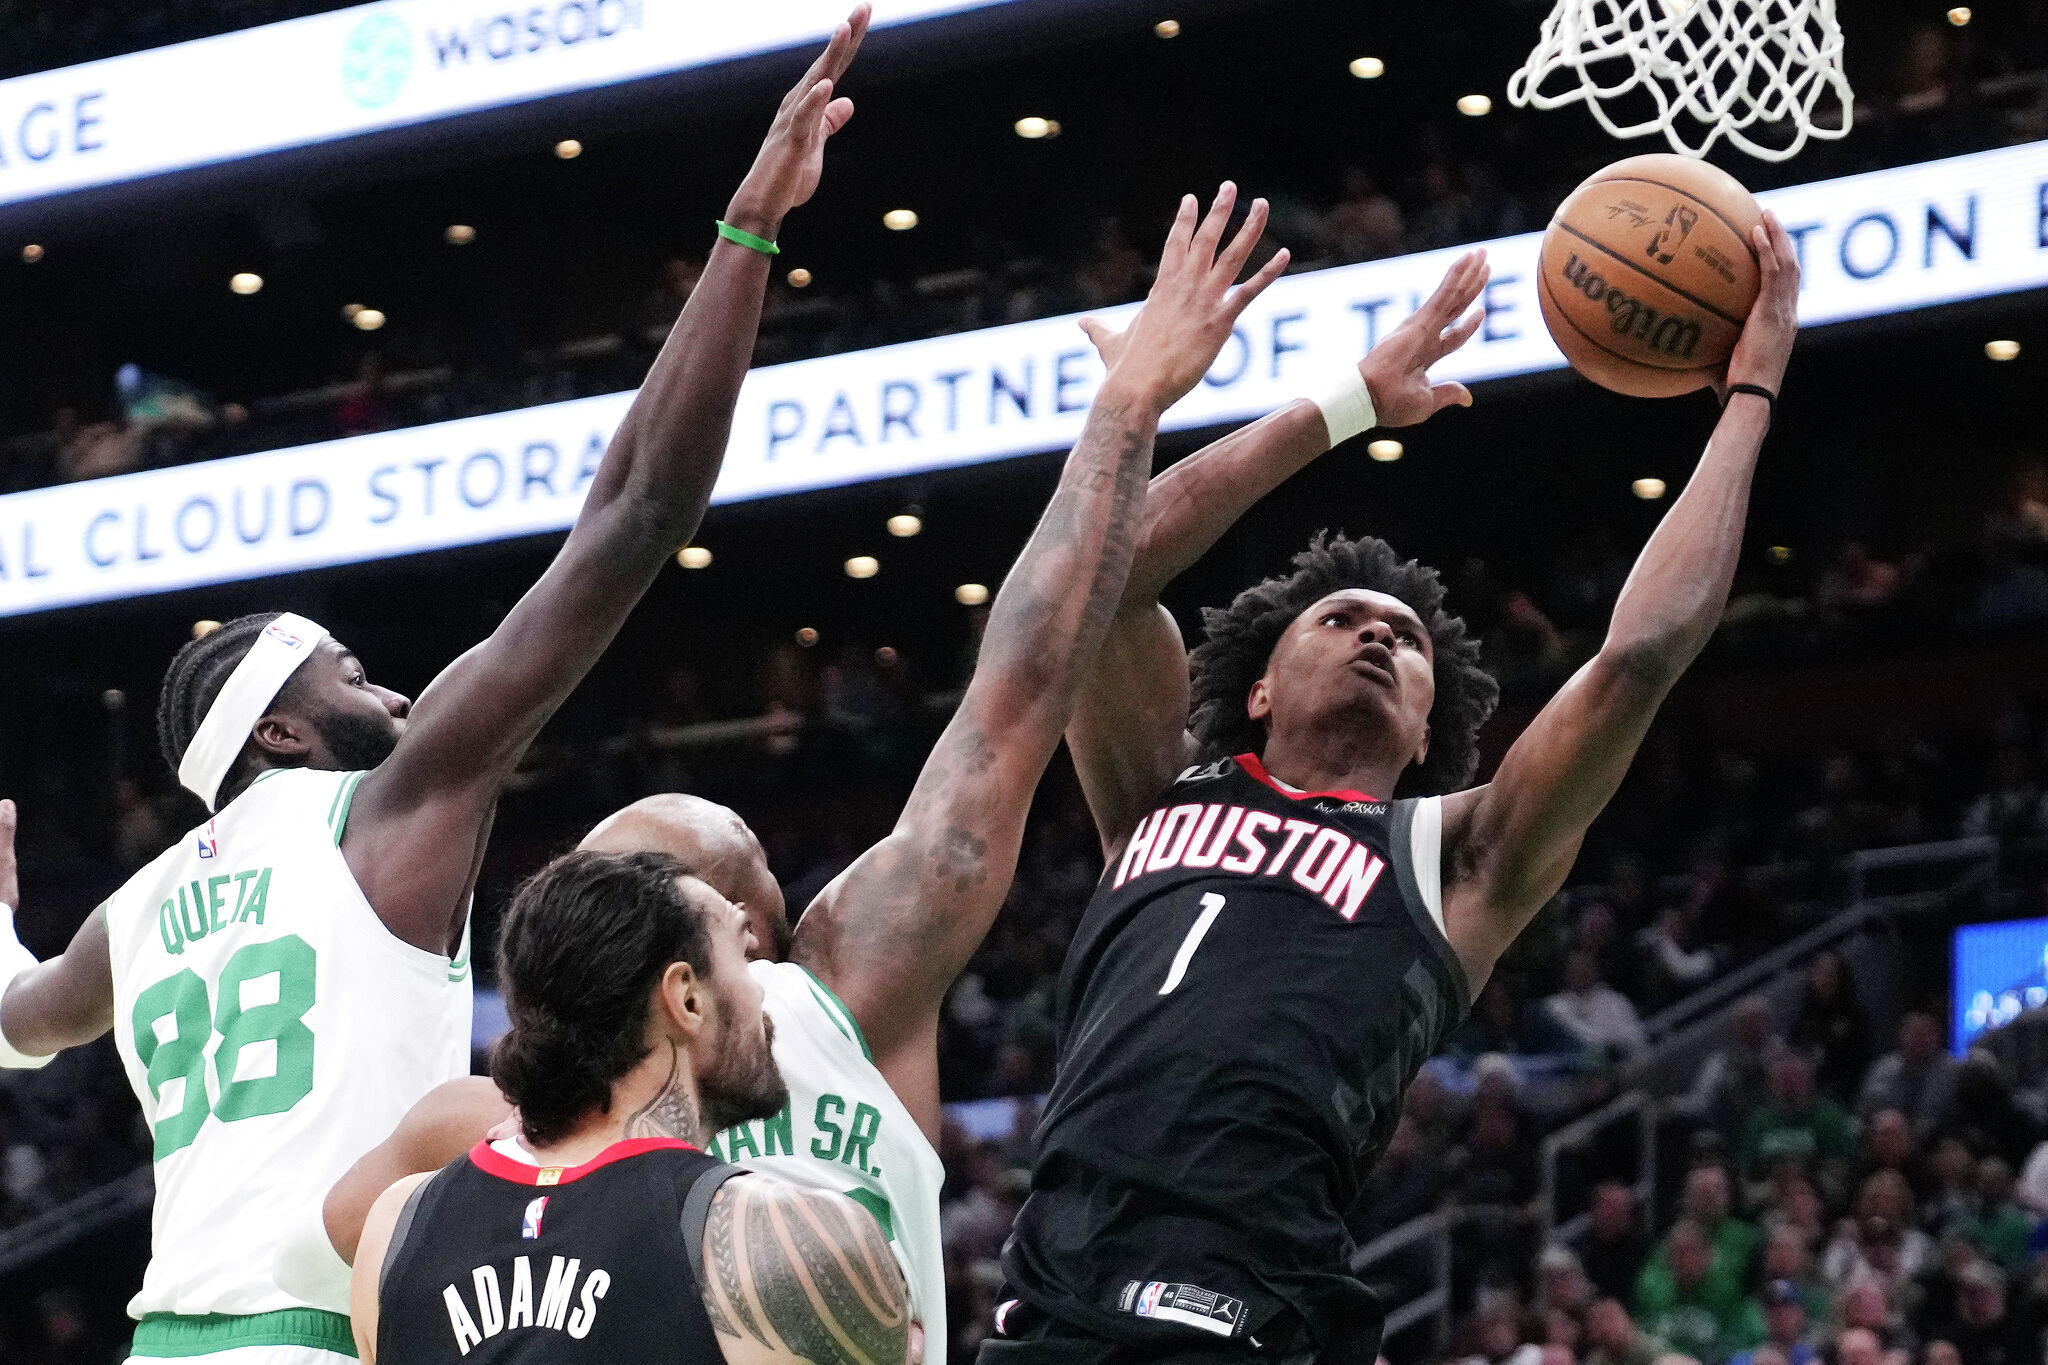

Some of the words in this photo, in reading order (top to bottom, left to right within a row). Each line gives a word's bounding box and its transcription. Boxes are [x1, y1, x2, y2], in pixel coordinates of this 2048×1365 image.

[0, 90, 106, 167] GE
[1563, 254, 1703, 359] Wilson
[83, 478, 332, 568] CLOUD
[367, 432, 607, 524] STORA
[764, 349, 1092, 463] PARTNE
[1202, 307, 1306, 389] OF
[1348, 272, 1522, 358] TE
[159, 867, 273, 956] QUETA
[1112, 803, 1387, 921] HOUSTON
[1158, 891, 1227, 996] 1
[132, 933, 317, 1163] 88
[810, 1093, 882, 1178] SR.
[442, 1255, 611, 1356] ADAMS
